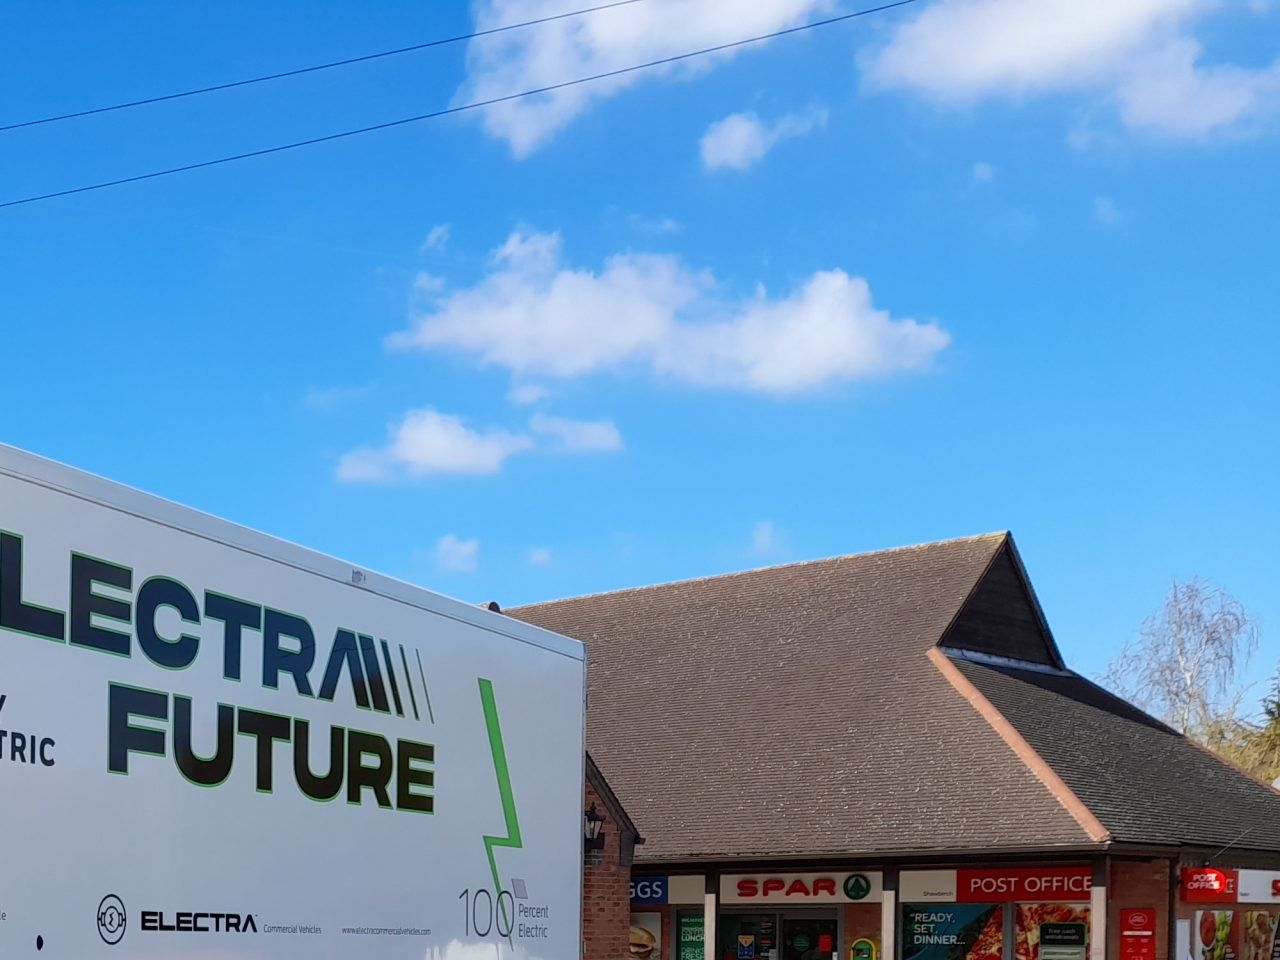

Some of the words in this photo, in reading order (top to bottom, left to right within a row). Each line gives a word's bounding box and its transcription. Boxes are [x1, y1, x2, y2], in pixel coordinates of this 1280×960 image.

[107, 681, 436, 815] FUTURE
[737, 878, 836, 897] SPAR
[970, 877, 1019, 893] POST
[1024, 876, 1092, 892] OFFICE
[459, 888, 515, 938] 100
[518, 903, 549, 918] Percent
[141, 911, 257, 933] ELECTRA
[263, 924, 298, 934] Commercial
[299, 924, 322, 934] Vehicles
[518, 924, 548, 938] Electric
